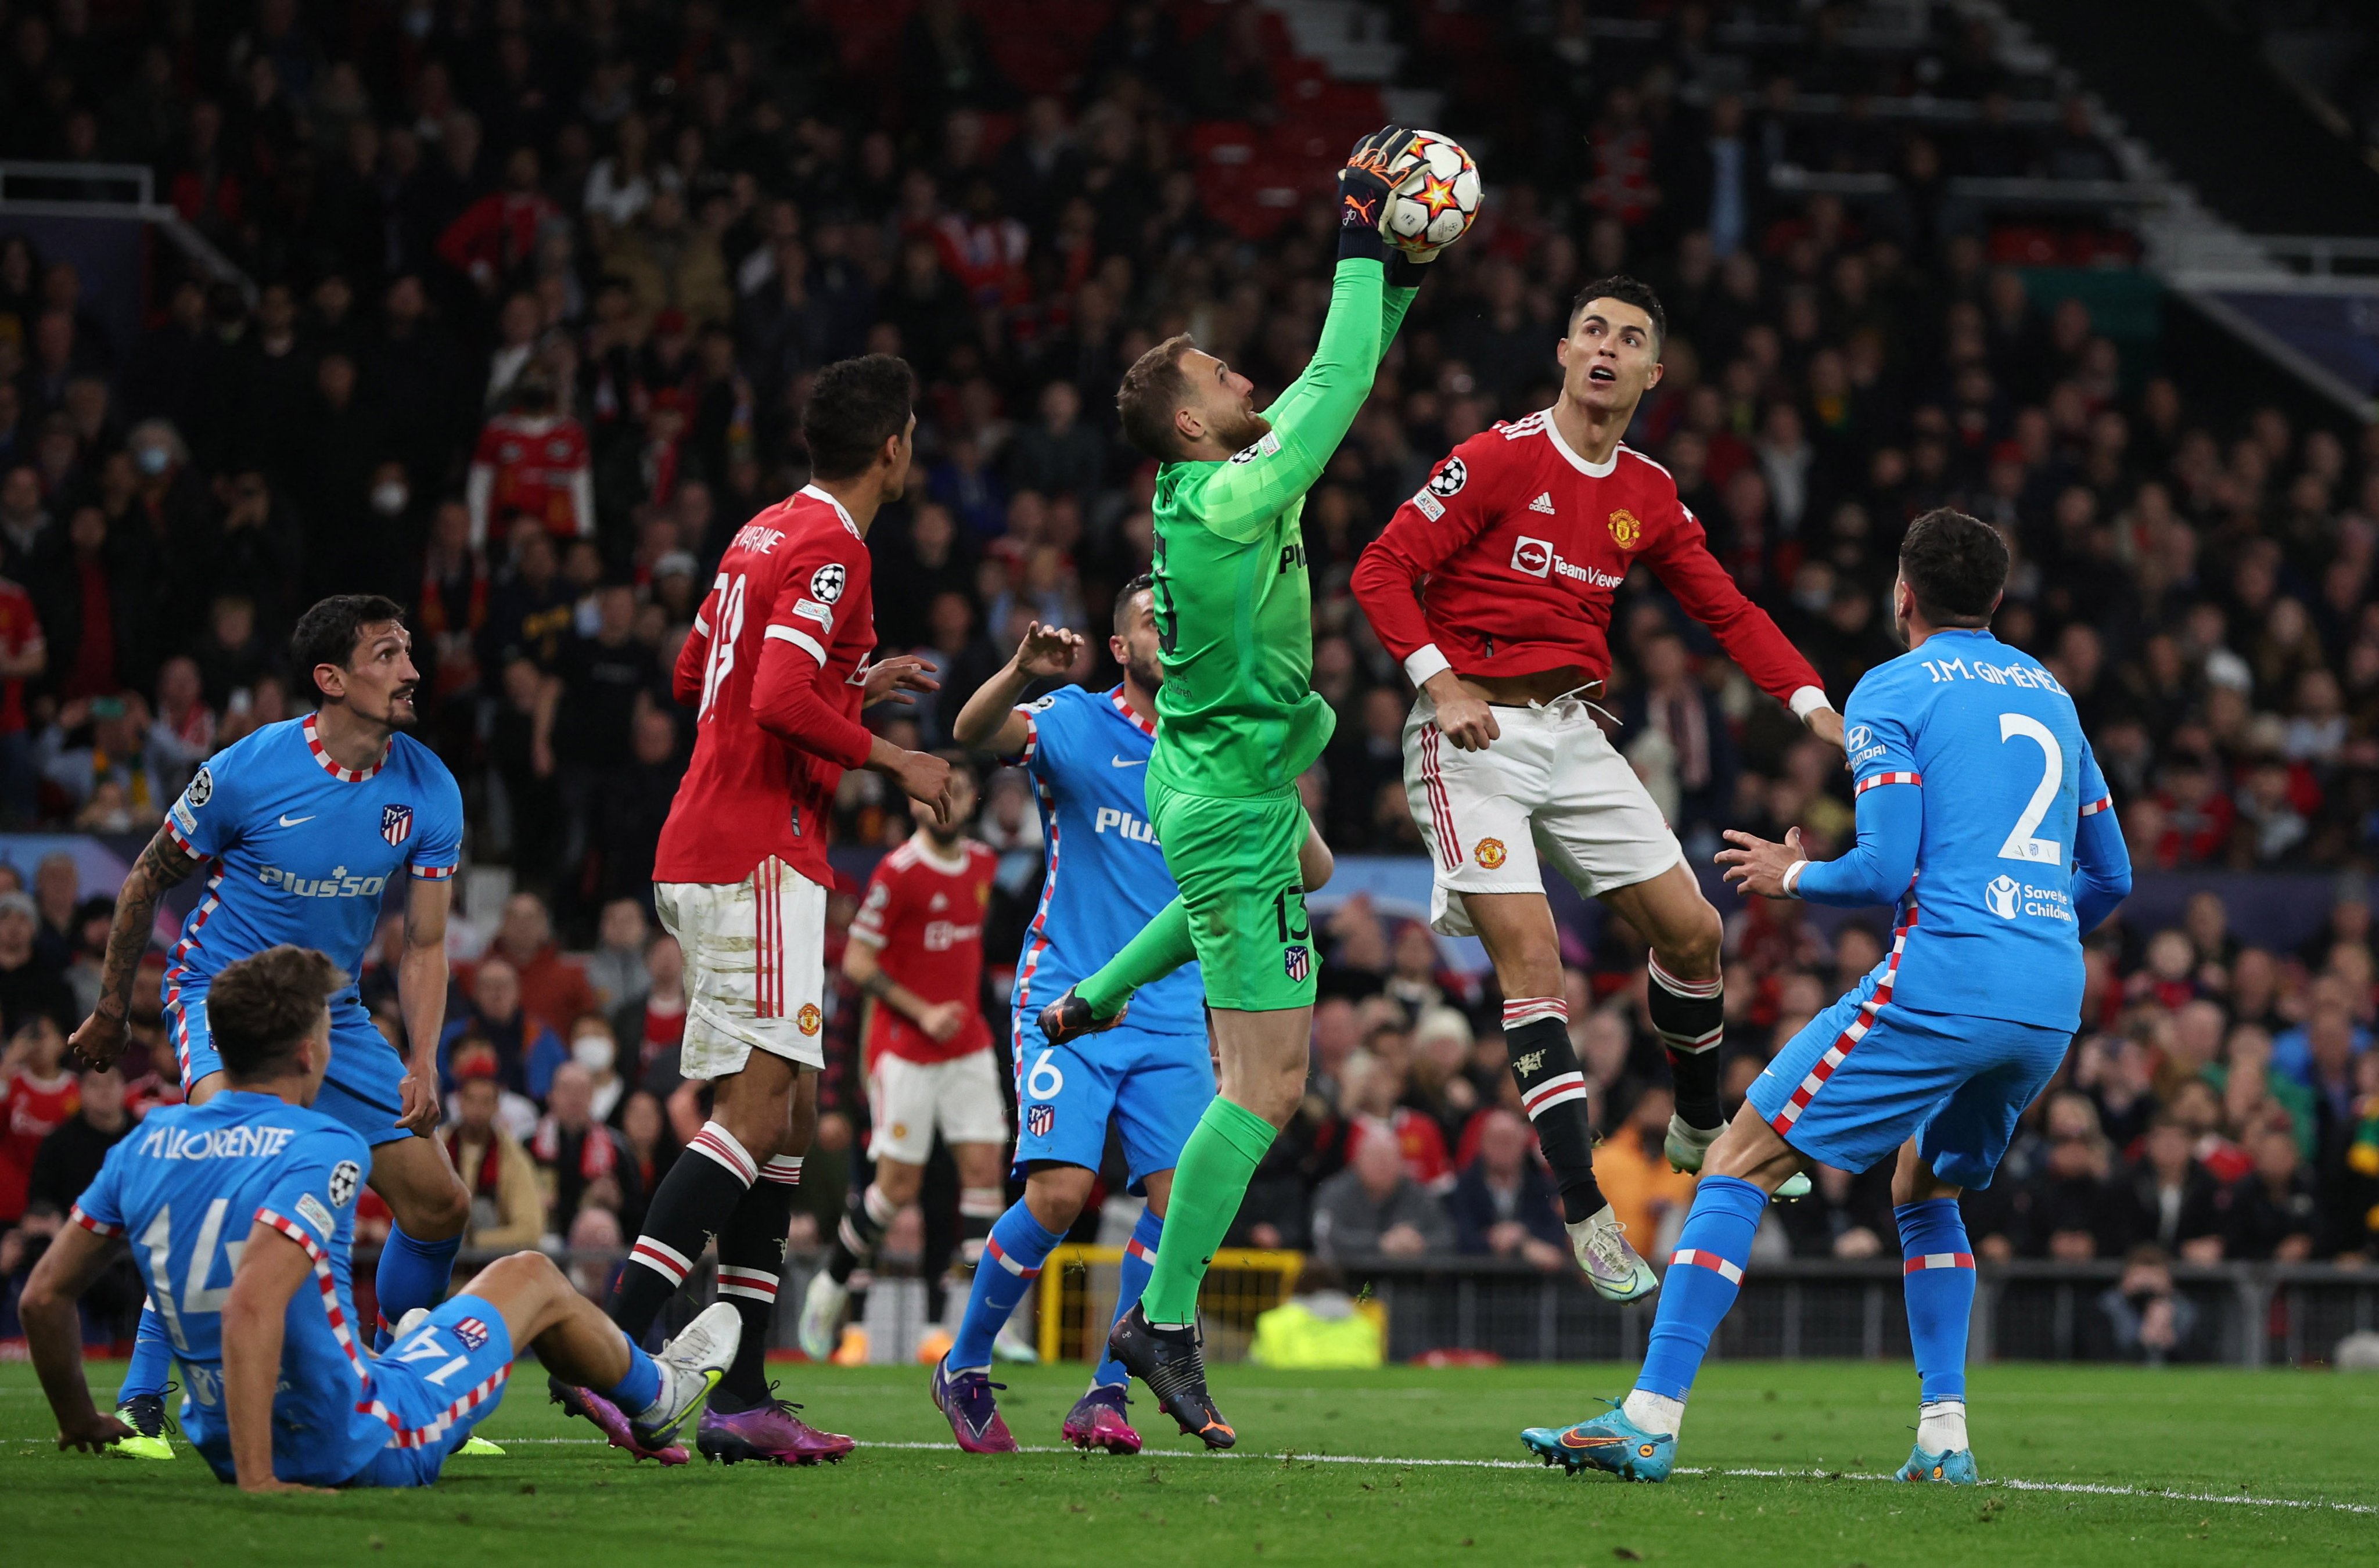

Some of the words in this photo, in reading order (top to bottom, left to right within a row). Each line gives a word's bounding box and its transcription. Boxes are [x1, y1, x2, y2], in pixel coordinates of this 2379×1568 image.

[1528, 503, 1556, 516] adidas
[1553, 554, 1625, 588] TeamViewe
[697, 573, 746, 713] 19
[1920, 657, 1975, 683] J.M.
[1973, 661, 2070, 697] GIMÉNEZ
[1997, 713, 2063, 866] 2
[259, 865, 391, 898] Plus50
[2024, 884, 2058, 901] Save
[1272, 884, 1310, 943] 13
[1027, 1049, 1063, 1101] 6
[140, 1198, 246, 1351] 14
[396, 1325, 470, 1387] 14
